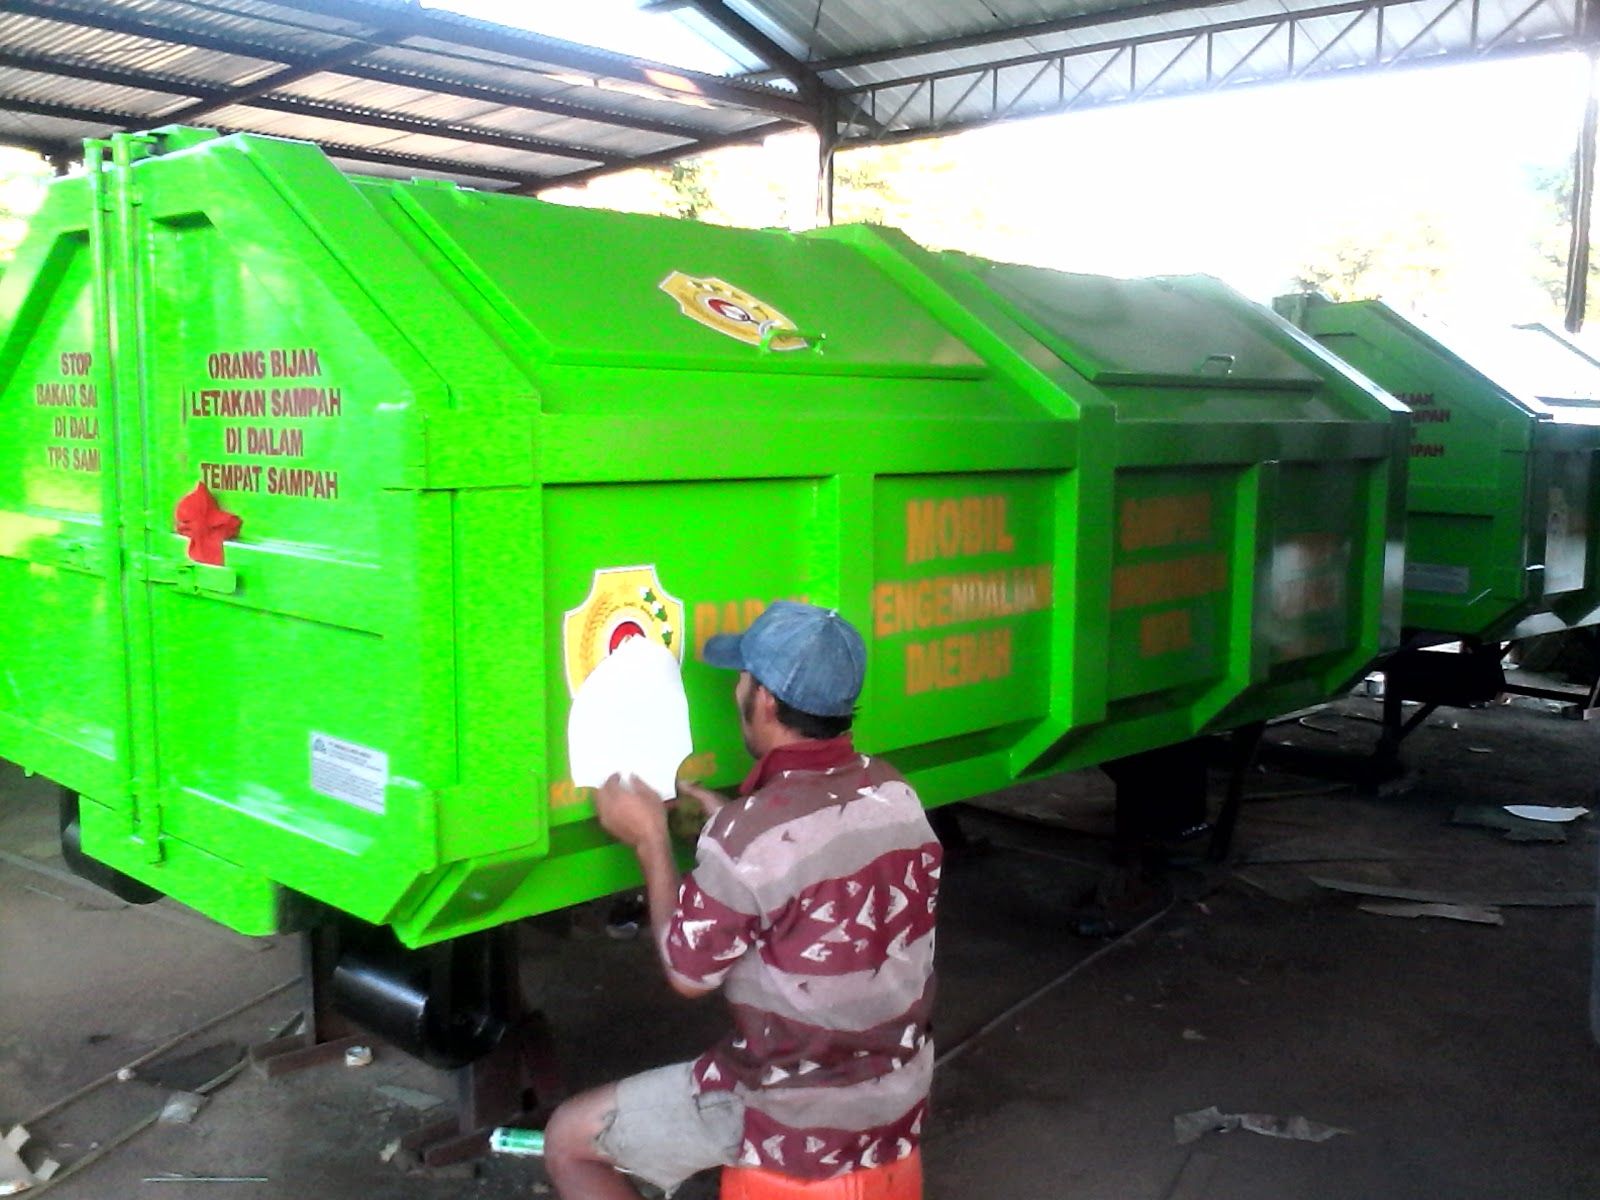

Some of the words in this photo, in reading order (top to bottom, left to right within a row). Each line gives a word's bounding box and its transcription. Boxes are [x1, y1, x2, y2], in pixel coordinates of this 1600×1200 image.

[60, 352, 92, 376] STOP
[208, 350, 265, 380] ORANG
[270, 348, 322, 378] BIJAK
[36, 384, 76, 407] BAKAR
[191, 389, 266, 417] LETAKAN
[271, 387, 341, 417] SAMPAH
[54, 416, 66, 438] DI
[226, 427, 242, 454] DI
[247, 427, 304, 456] DALAM
[47, 446, 70, 470] TPS
[200, 463, 262, 493] TEMPAT
[267, 467, 339, 499] SAMPAH
[906, 494, 1016, 564] MOBIL
[905, 627, 1012, 696] DAERAH
